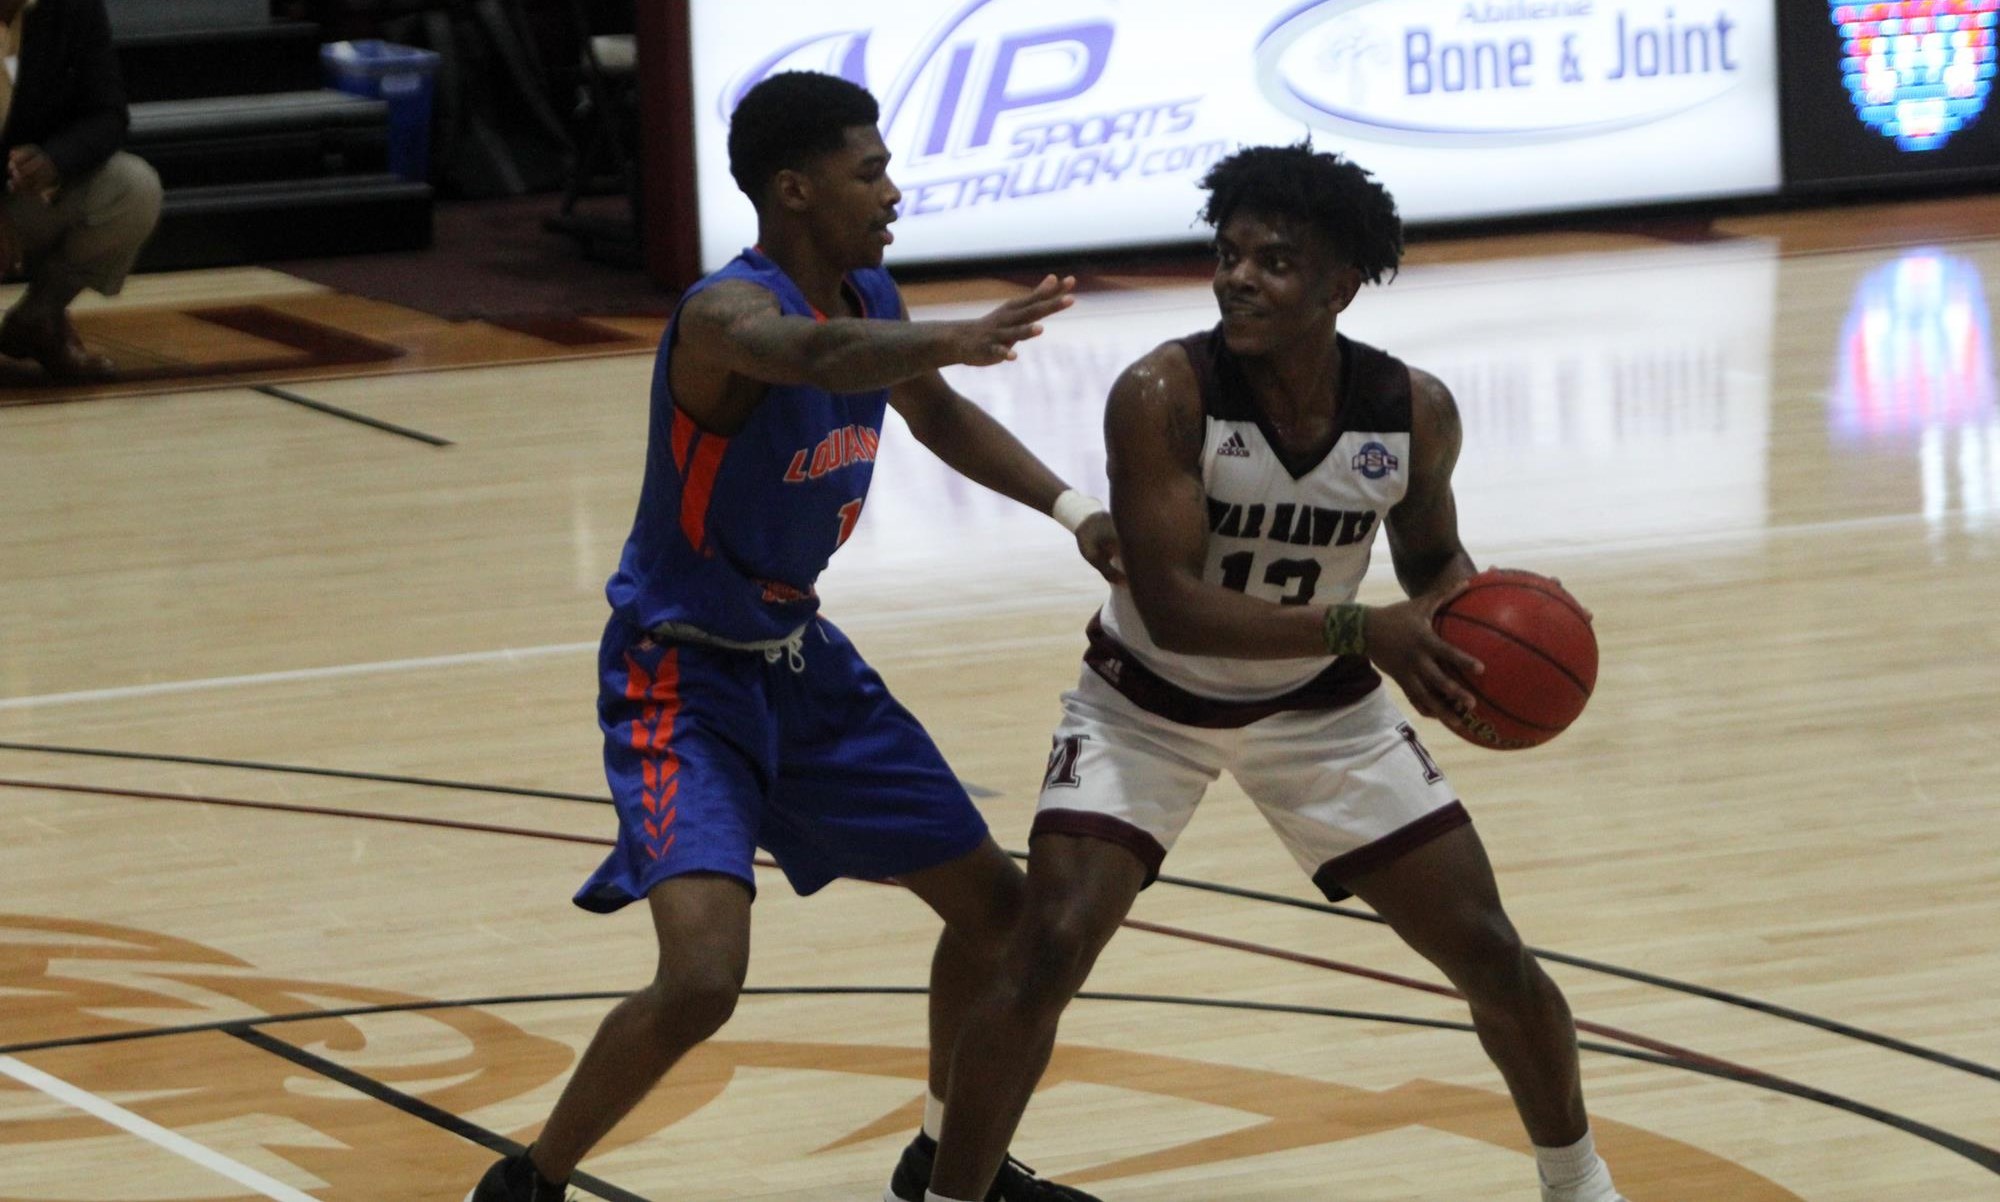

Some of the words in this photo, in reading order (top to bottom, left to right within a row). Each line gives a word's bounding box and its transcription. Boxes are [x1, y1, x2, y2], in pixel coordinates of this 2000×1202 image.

[1405, 28, 1533, 95] Bone
[1560, 34, 1583, 82] &
[1607, 8, 1737, 80] Joint
[1007, 95, 1206, 160] SPORTS
